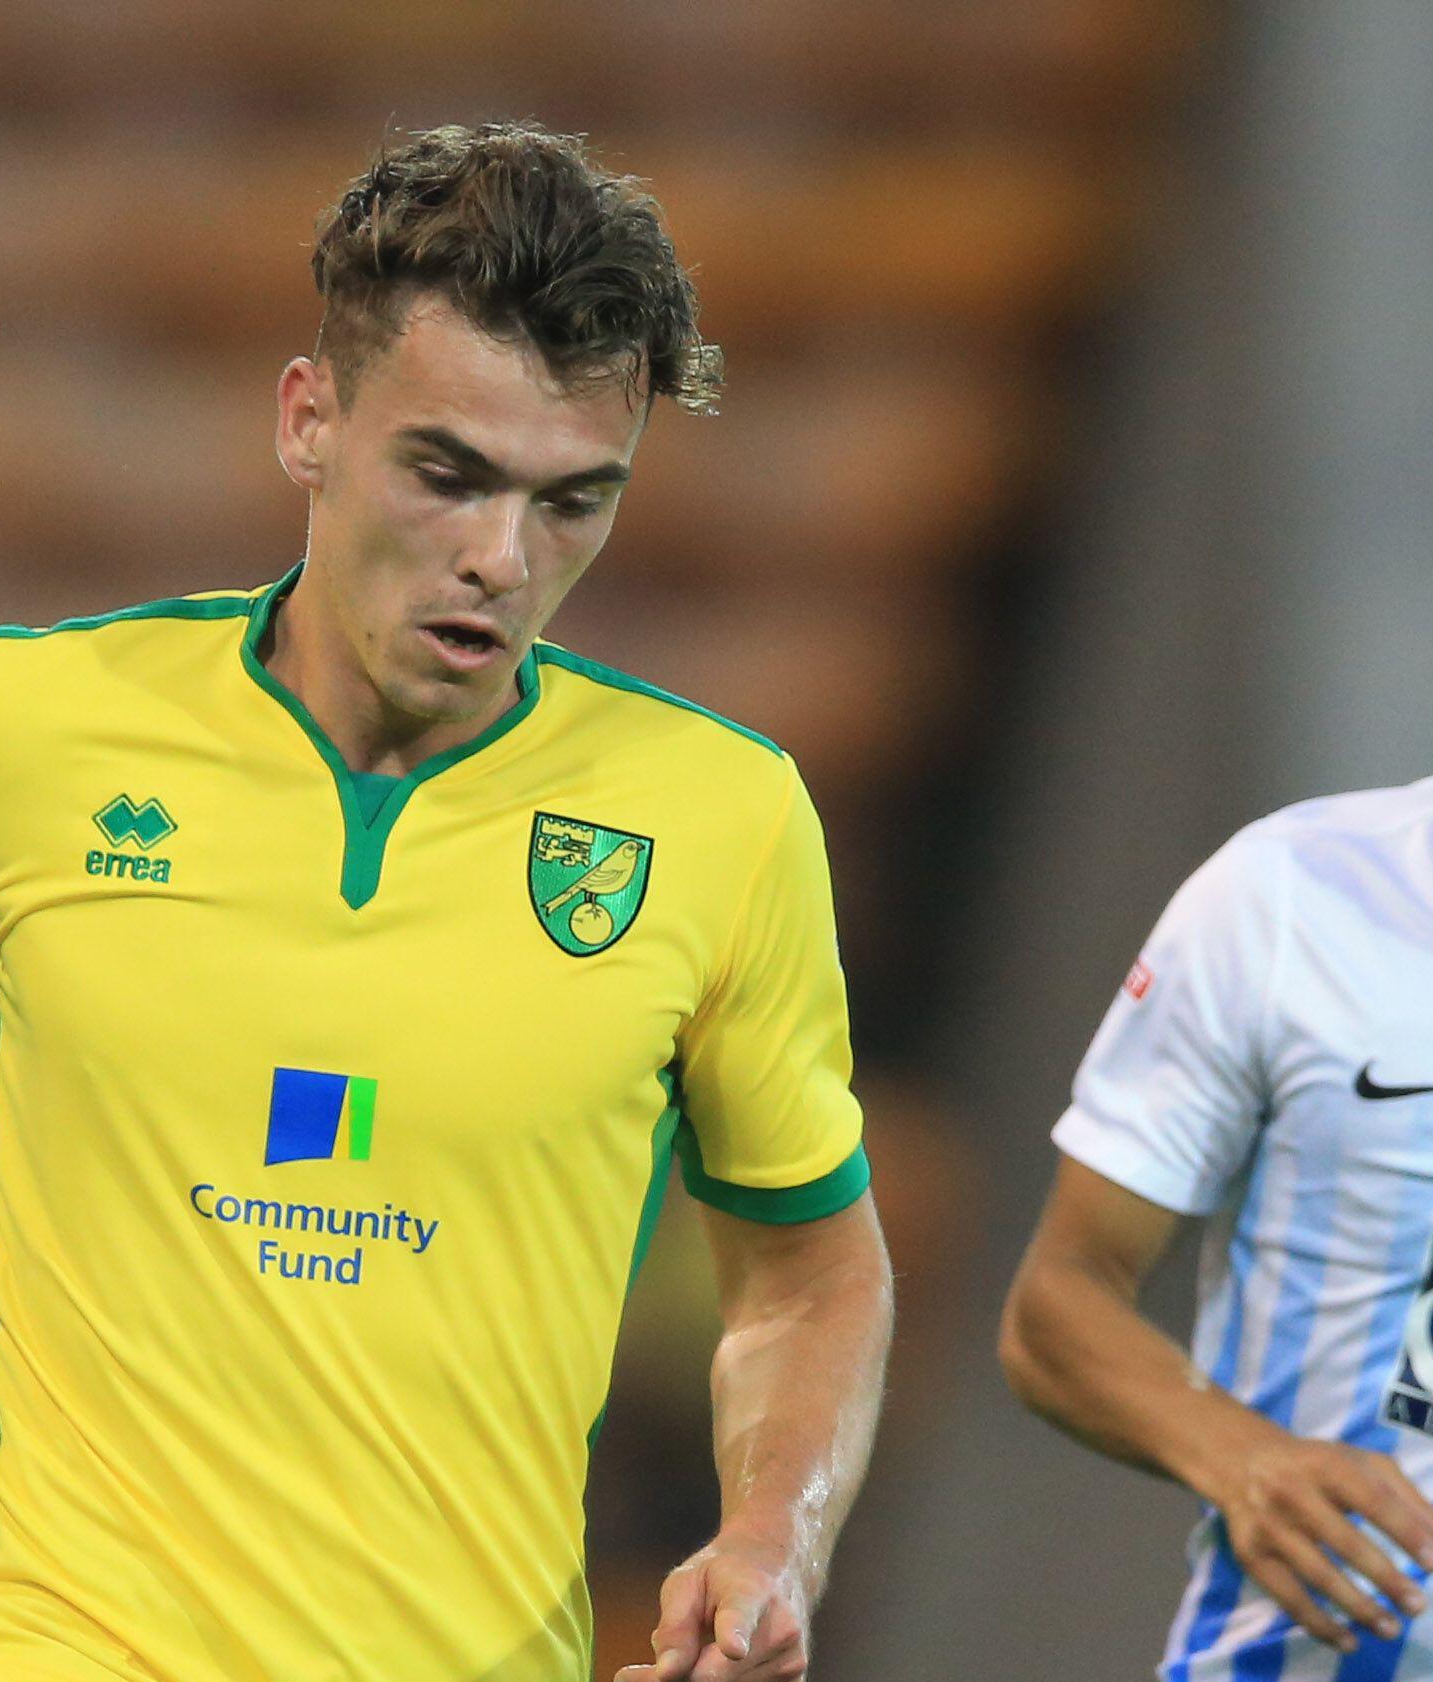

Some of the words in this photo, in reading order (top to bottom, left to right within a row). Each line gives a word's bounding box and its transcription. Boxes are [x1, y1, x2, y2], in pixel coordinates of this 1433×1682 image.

[85, 850, 172, 884] errea
[189, 1183, 439, 1254] Community
[258, 1239, 363, 1286] Fund
